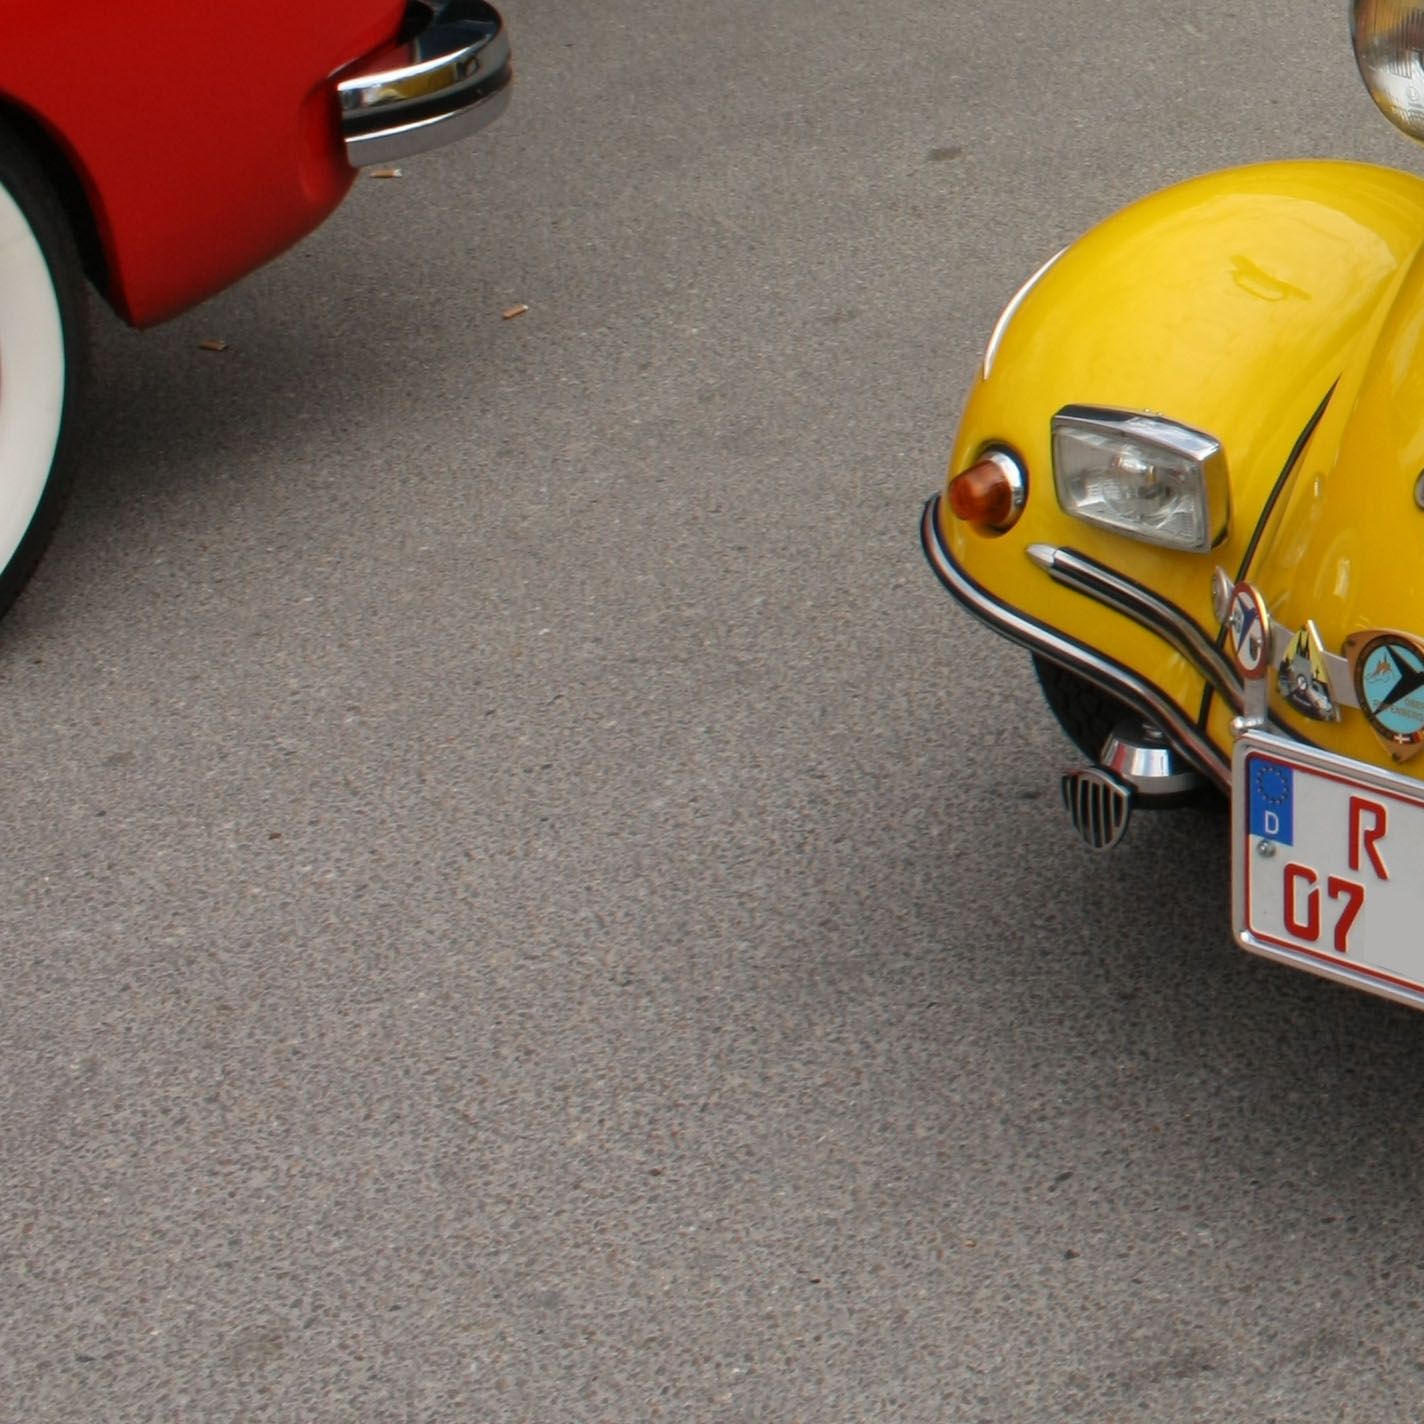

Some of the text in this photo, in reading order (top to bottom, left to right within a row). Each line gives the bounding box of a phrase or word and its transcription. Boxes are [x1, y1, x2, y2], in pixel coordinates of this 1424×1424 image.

[1264, 811, 1280, 835] D
[1347, 795, 1390, 882] R
[1282, 861, 1366, 954] 07
